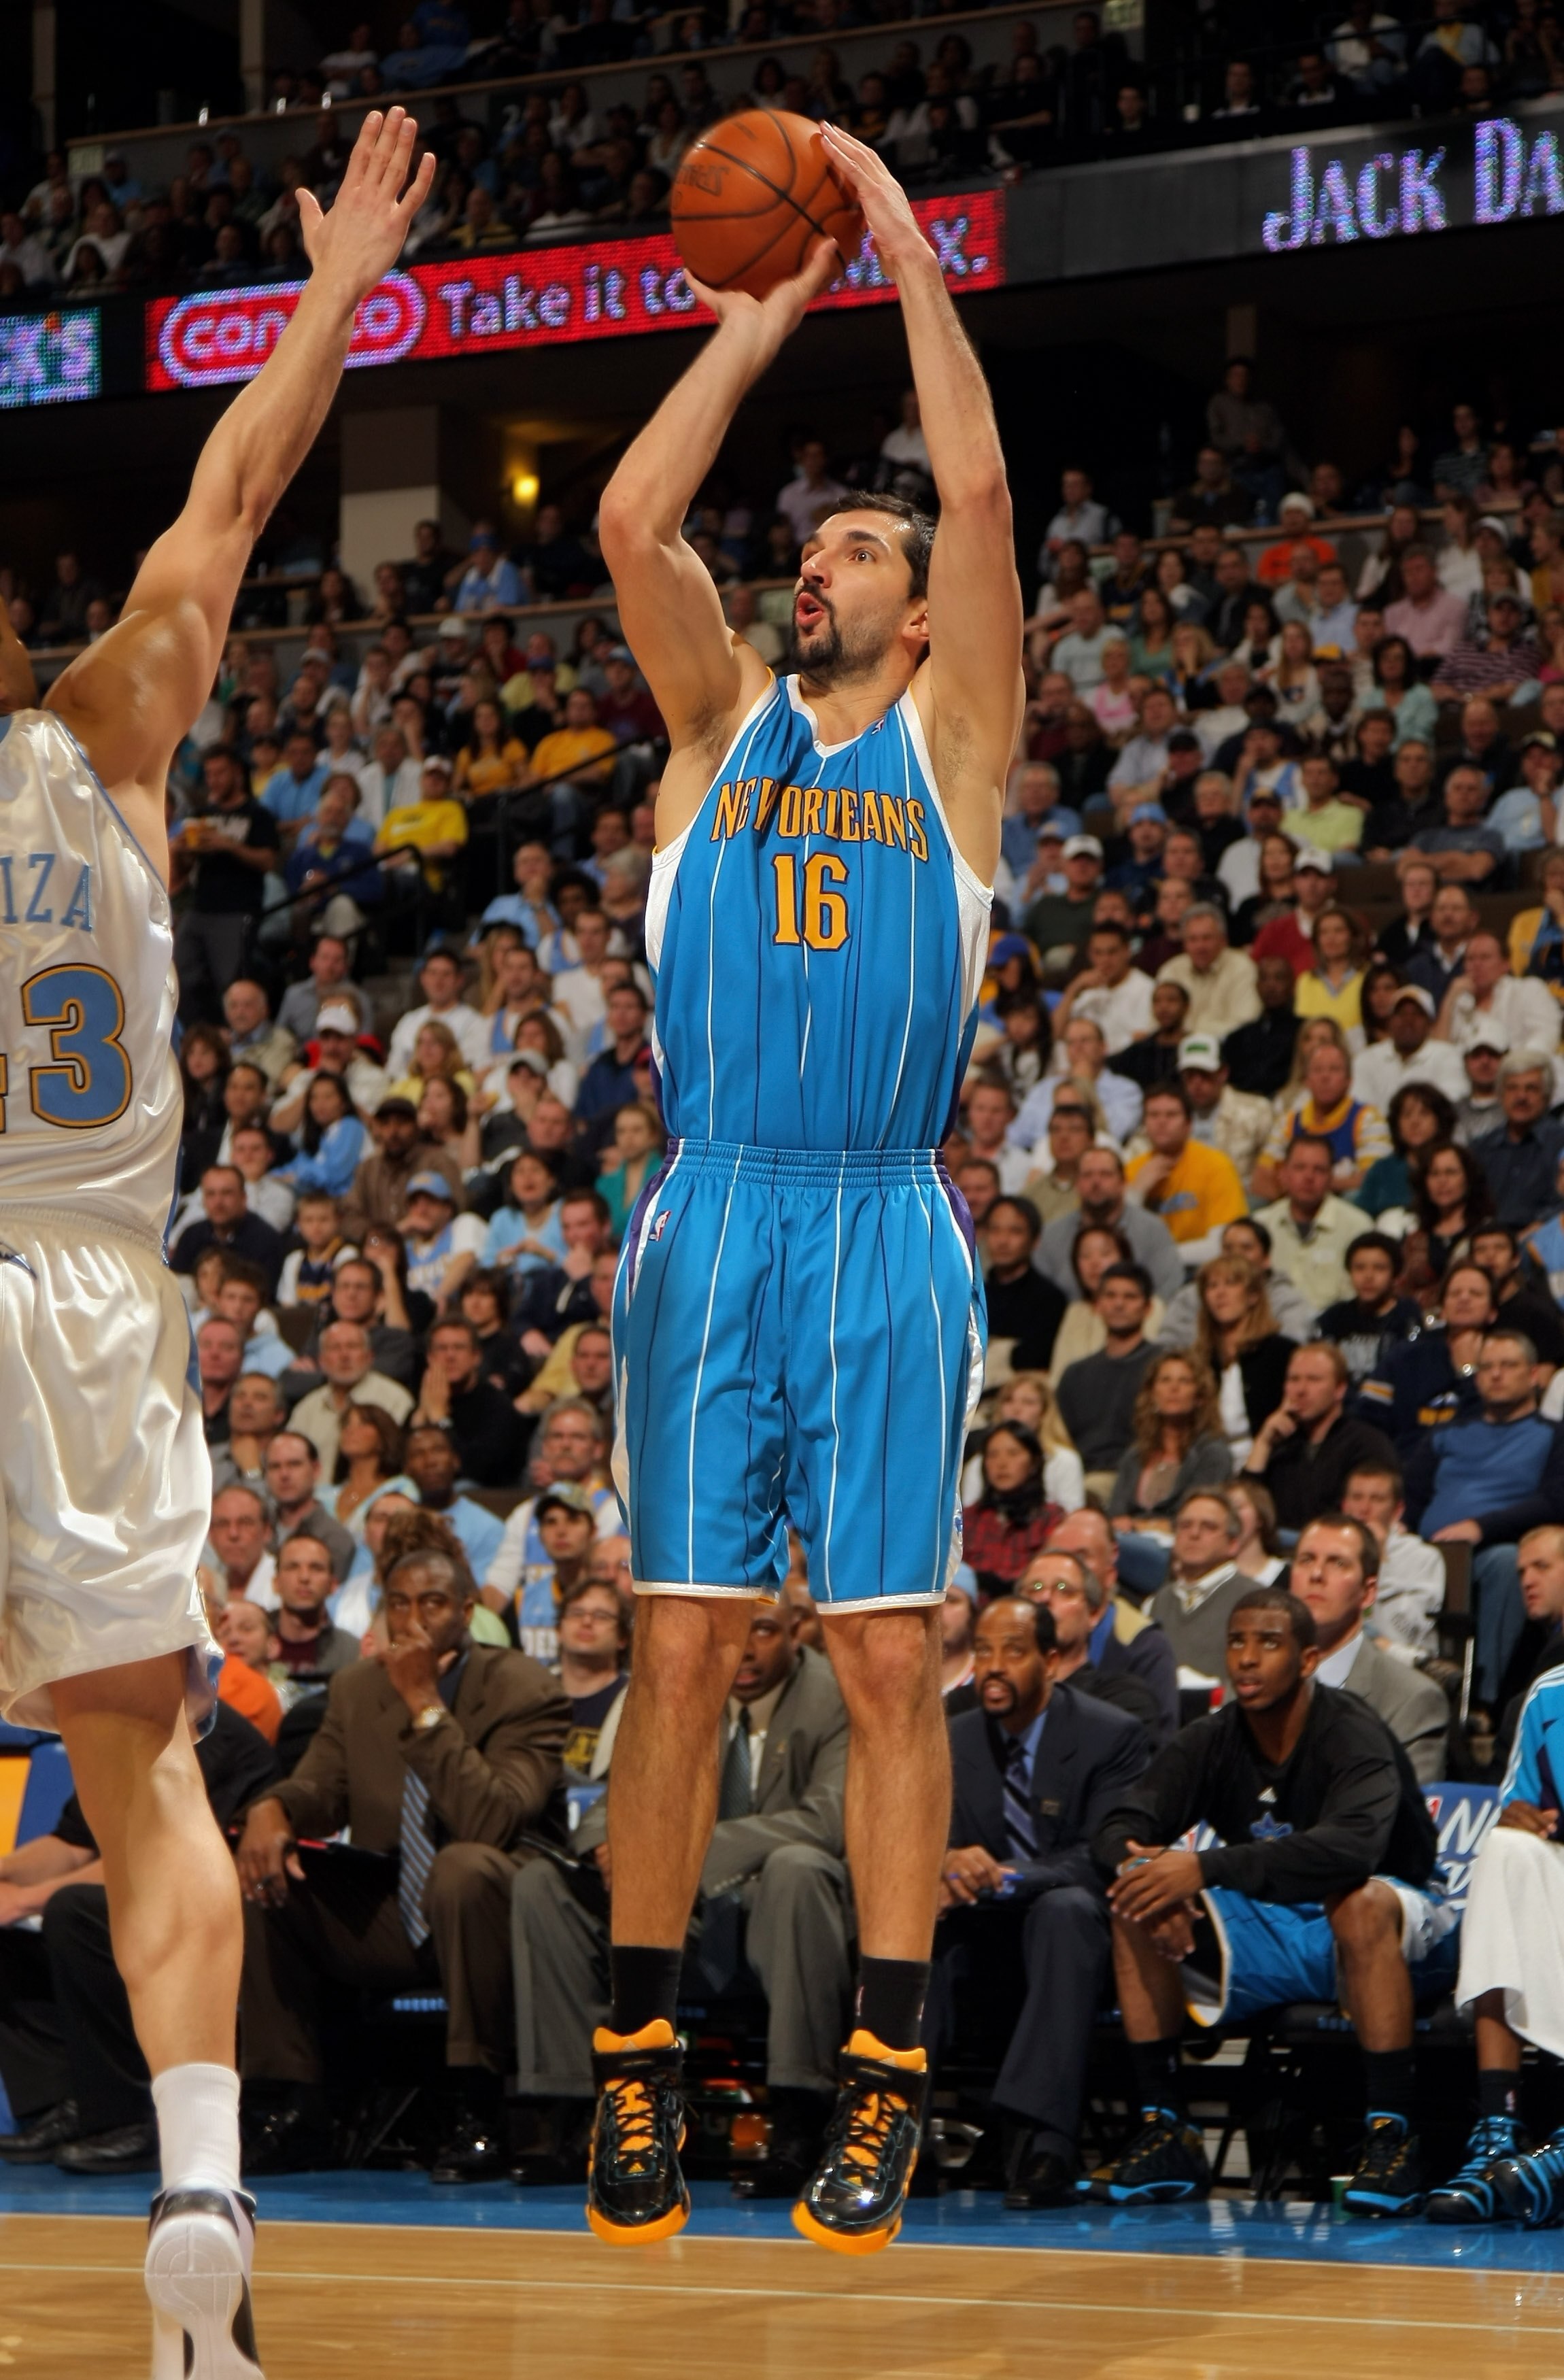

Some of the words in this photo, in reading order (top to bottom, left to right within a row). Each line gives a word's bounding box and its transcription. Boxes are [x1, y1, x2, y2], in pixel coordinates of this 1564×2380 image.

[1263, 145, 1450, 252] JACK
[438, 273, 571, 339] Take
[584, 263, 627, 323] it
[639, 265, 696, 315] to
[777, 785, 930, 864] ORLEANS
[772, 850, 851, 952] 16
[0, 962, 133, 1129] 3
